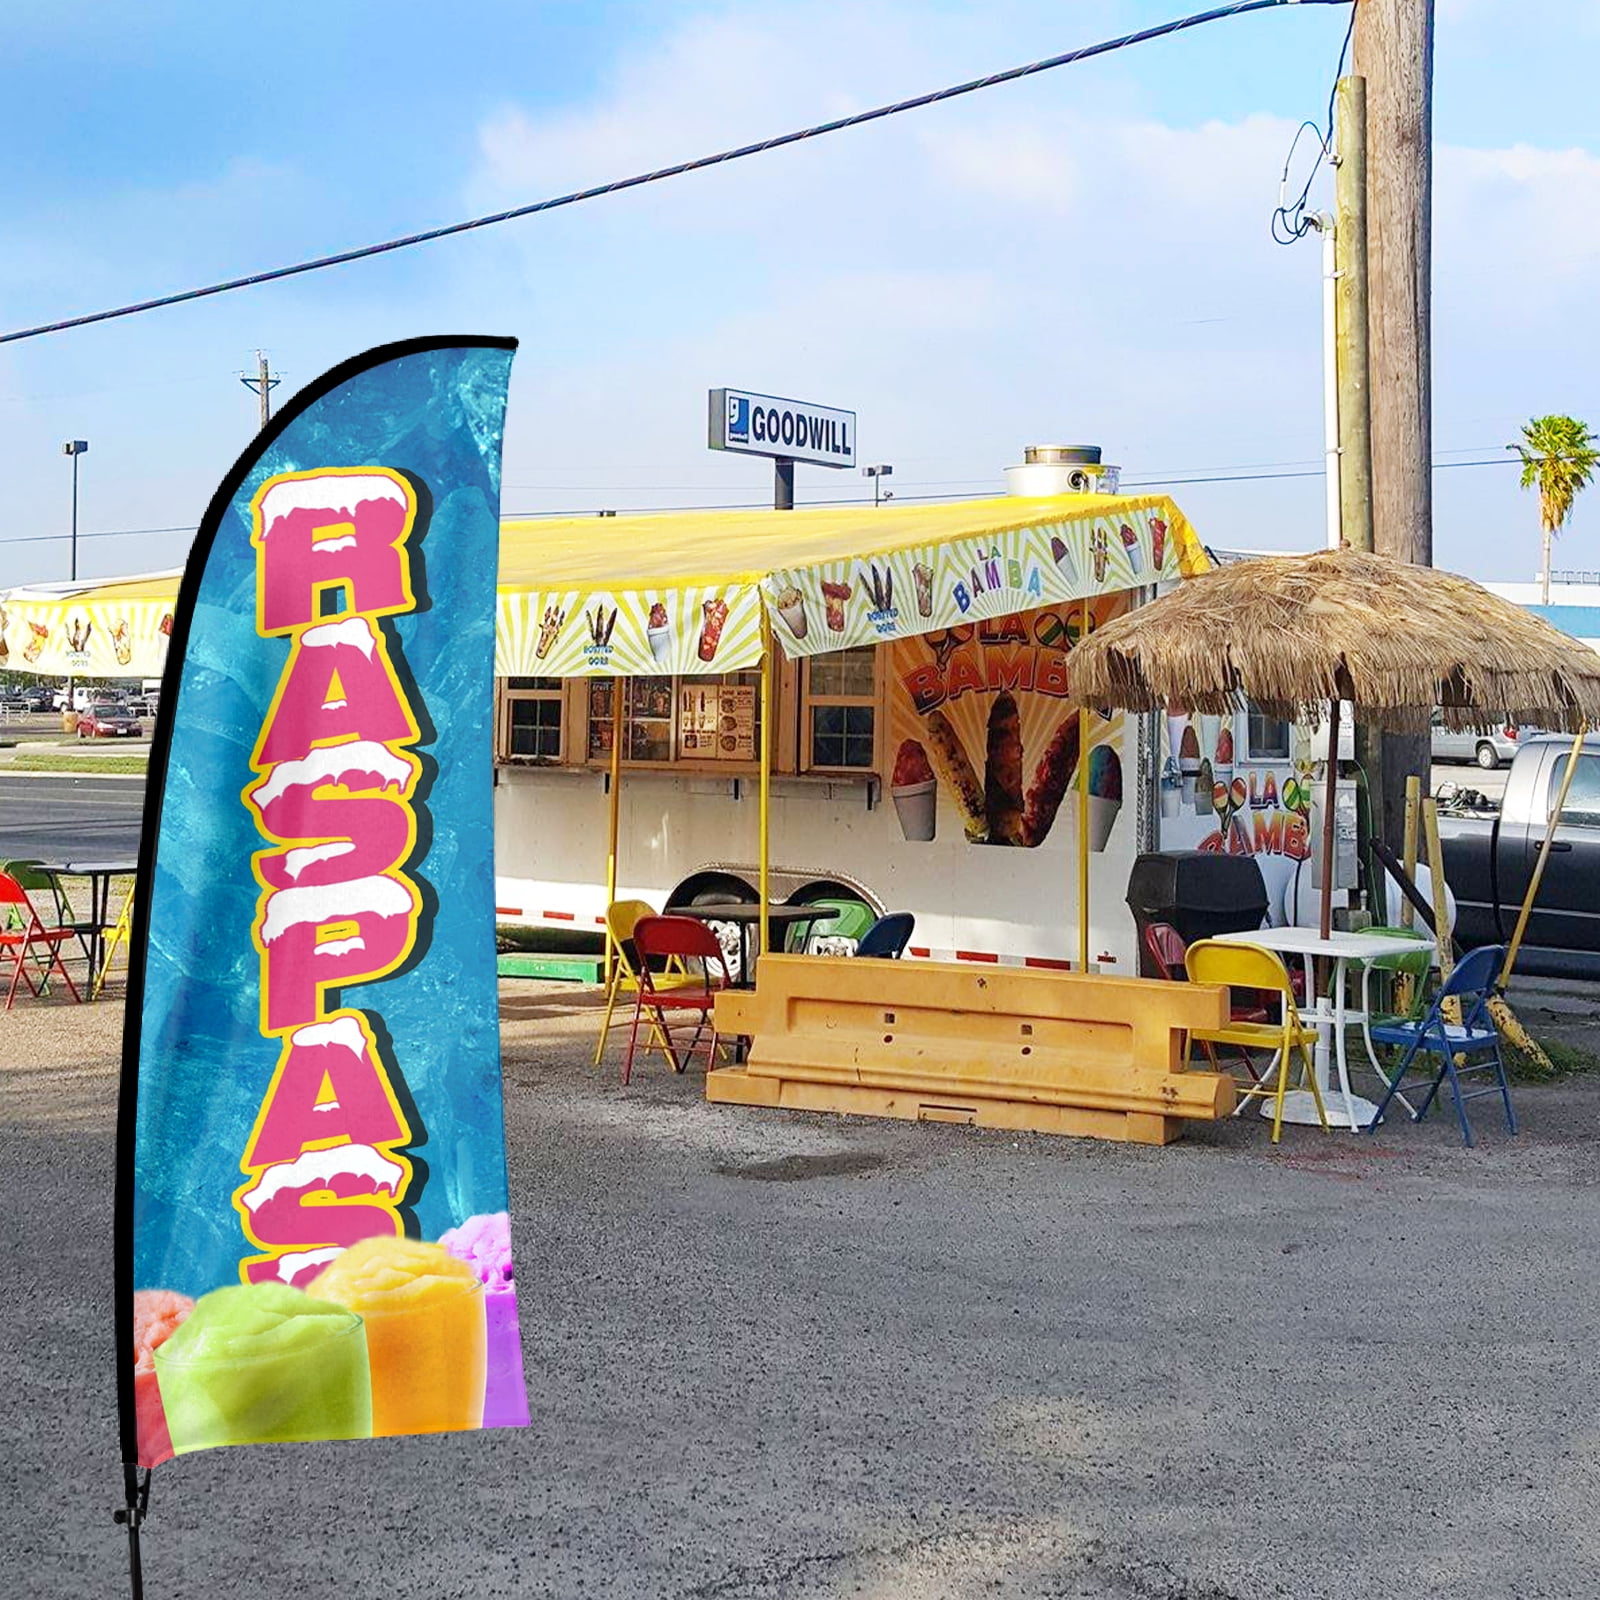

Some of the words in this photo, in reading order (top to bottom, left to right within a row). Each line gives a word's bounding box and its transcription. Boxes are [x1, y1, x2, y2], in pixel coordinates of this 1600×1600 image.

[752, 405, 852, 456] GOODWILL
[976, 546, 1002, 561] LA
[952, 559, 1041, 614] BAMBA
[978, 613, 1031, 646] LA
[902, 645, 1112, 721] BAMB
[1250, 770, 1281, 810] LA
